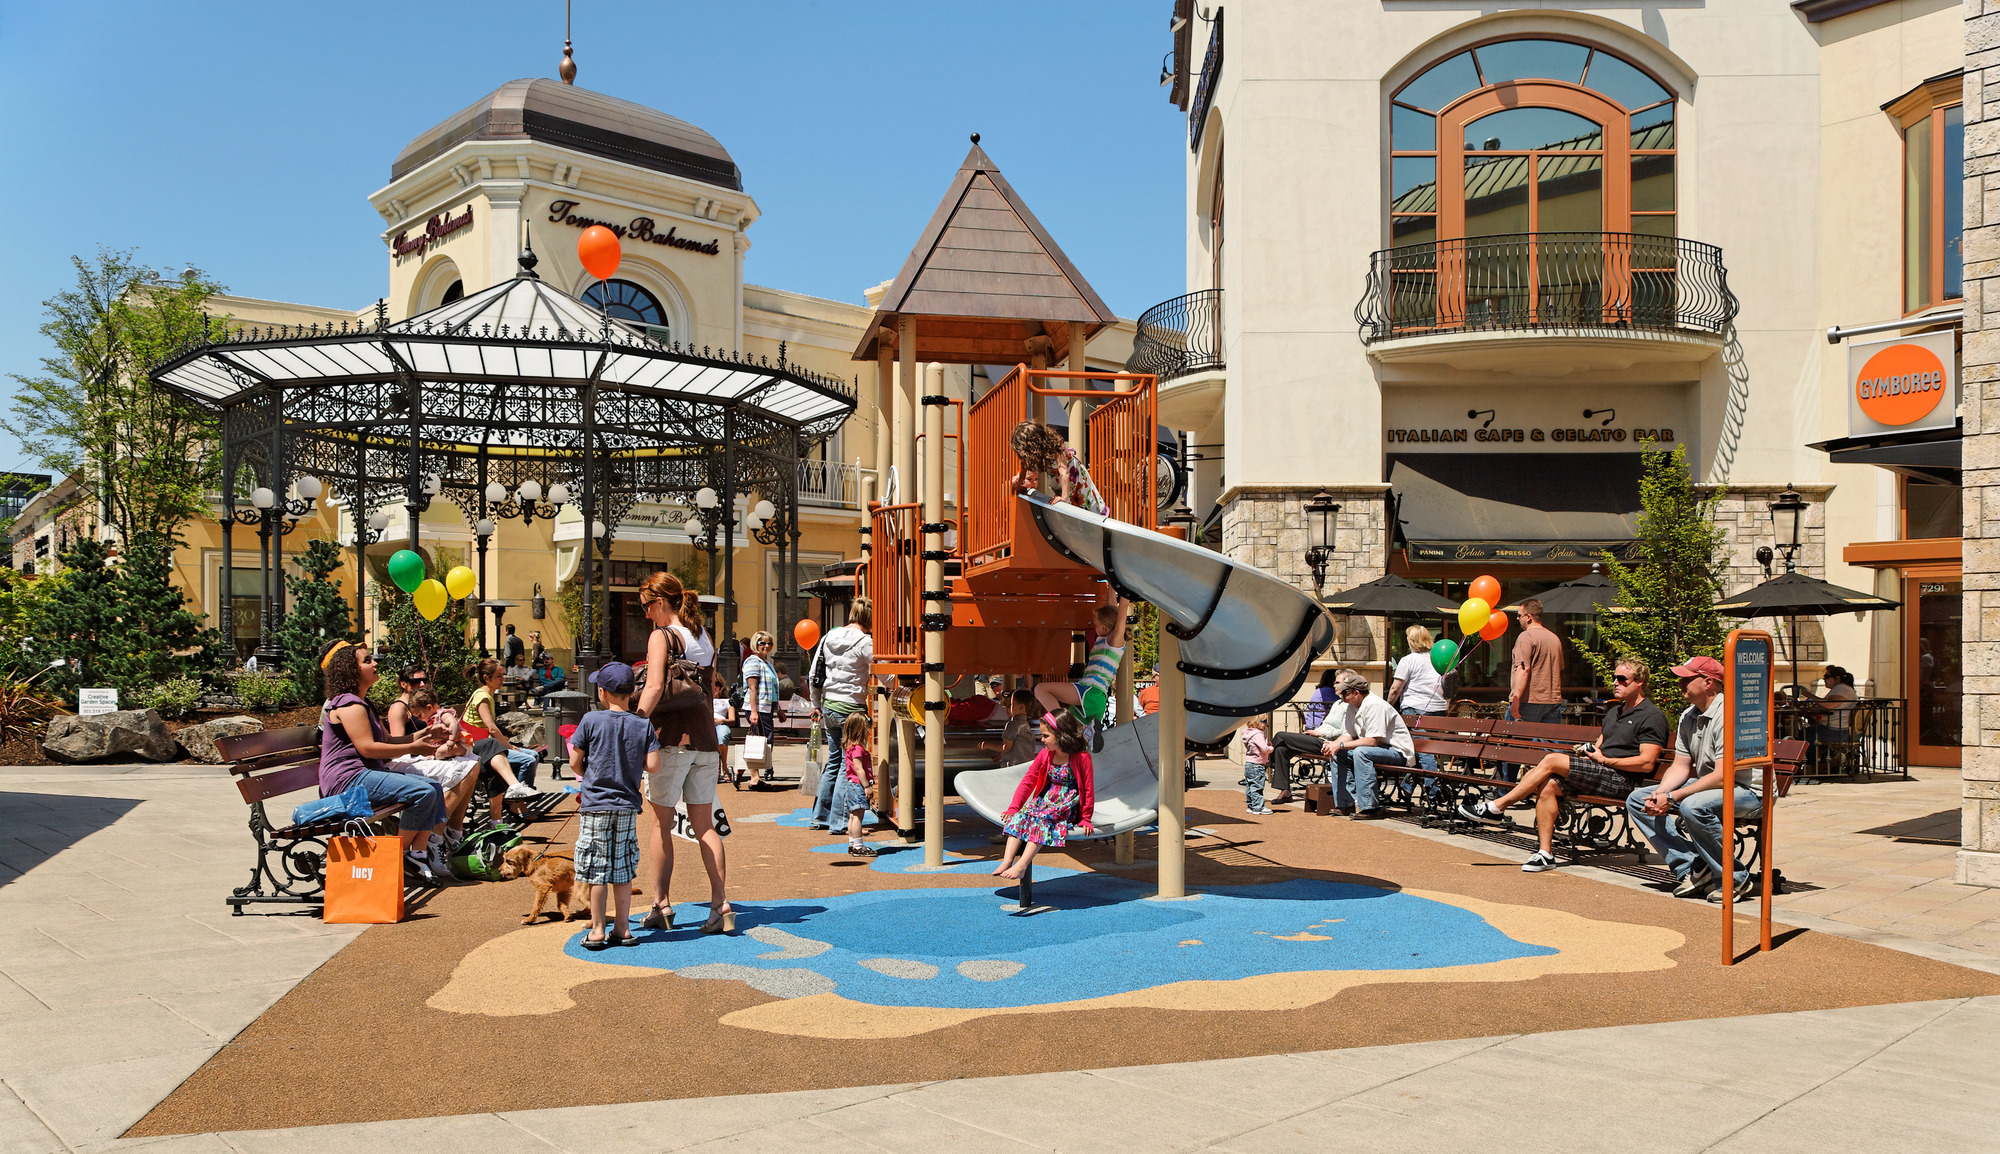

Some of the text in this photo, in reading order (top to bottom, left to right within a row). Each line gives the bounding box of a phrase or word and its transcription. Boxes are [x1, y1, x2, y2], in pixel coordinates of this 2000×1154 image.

[393, 231, 427, 258] Tommy
[628, 217, 720, 256] Bahama's
[1388, 429, 1675, 442] ITALIAN CAFE & GELATO BAR
[621, 510, 659, 527] Tommy
[1455, 544, 1485, 560] Gelato
[1495, 549, 1532, 557] ESPRESSO
[1547, 544, 1576, 560] Gelato
[1921, 584, 1945, 593] 7291
[1737, 652, 1765, 664] WELCOME
[352, 865, 374, 881] lucy
